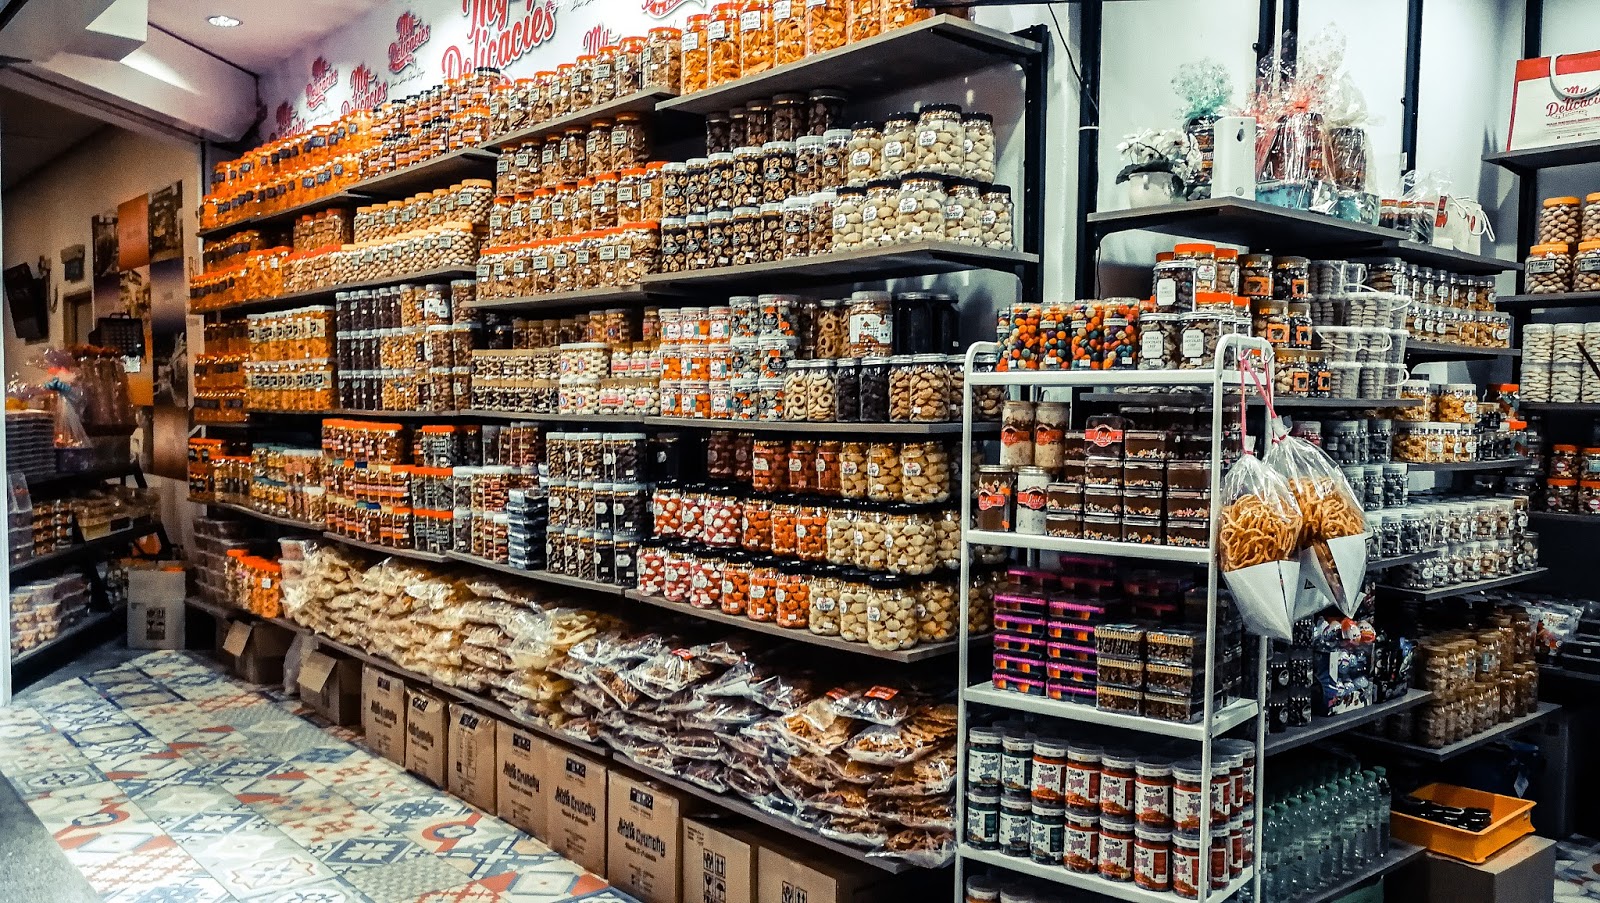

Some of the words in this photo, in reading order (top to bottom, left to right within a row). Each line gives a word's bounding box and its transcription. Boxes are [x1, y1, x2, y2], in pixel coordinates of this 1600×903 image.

[462, 0, 508, 40] My
[388, 25, 429, 63] Delicacies
[442, 0, 556, 80] Delicacies
[341, 81, 387, 115] Dlicacies
[1546, 92, 1600, 117] Delicaci
[635, 828, 666, 858] Crunchy
